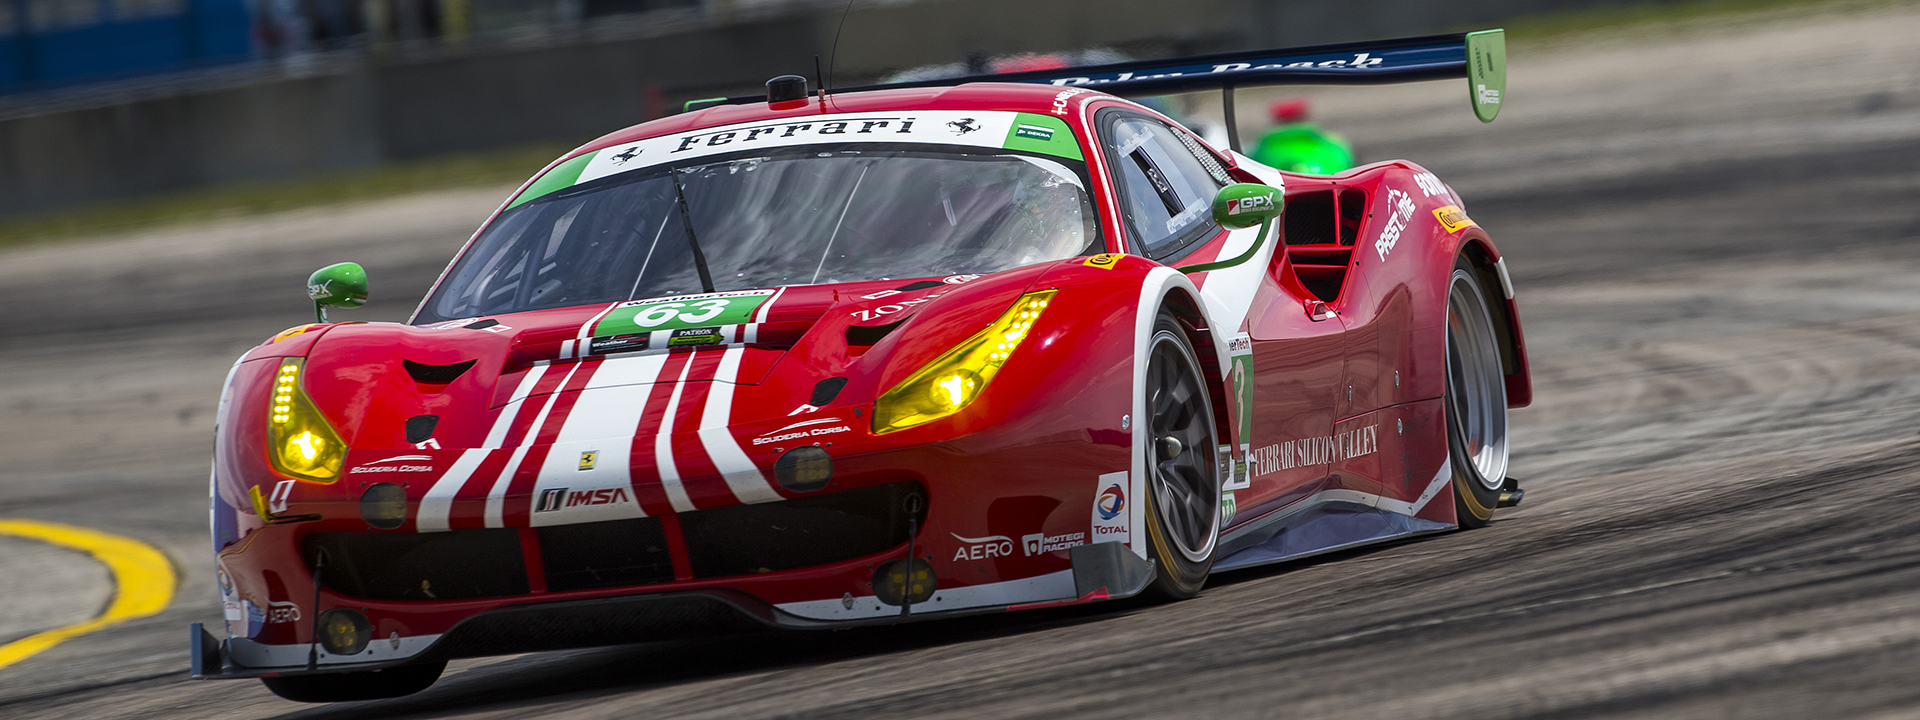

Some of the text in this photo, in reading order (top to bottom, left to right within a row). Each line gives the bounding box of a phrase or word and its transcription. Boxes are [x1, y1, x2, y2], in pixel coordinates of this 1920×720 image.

[670, 118, 916, 153] Ferrari
[1240, 192, 1274, 209] GPX
[626, 290, 770, 306] WeatherTech
[633, 299, 731, 328] 63
[752, 425, 851, 446] SCUDERIA CORSA
[1254, 440, 1296, 477] FERRARI
[1297, 435, 1337, 467] SILICON
[1339, 424, 1379, 461] VALLEY
[398, 464, 433, 472] CORSA
[565, 488, 629, 507] IMSA
[1044, 532, 1085, 543] MOTEGI
[1094, 525, 1128, 535] TOTAL
[952, 543, 1014, 562] AERO
[1043, 540, 1084, 553] RACING
